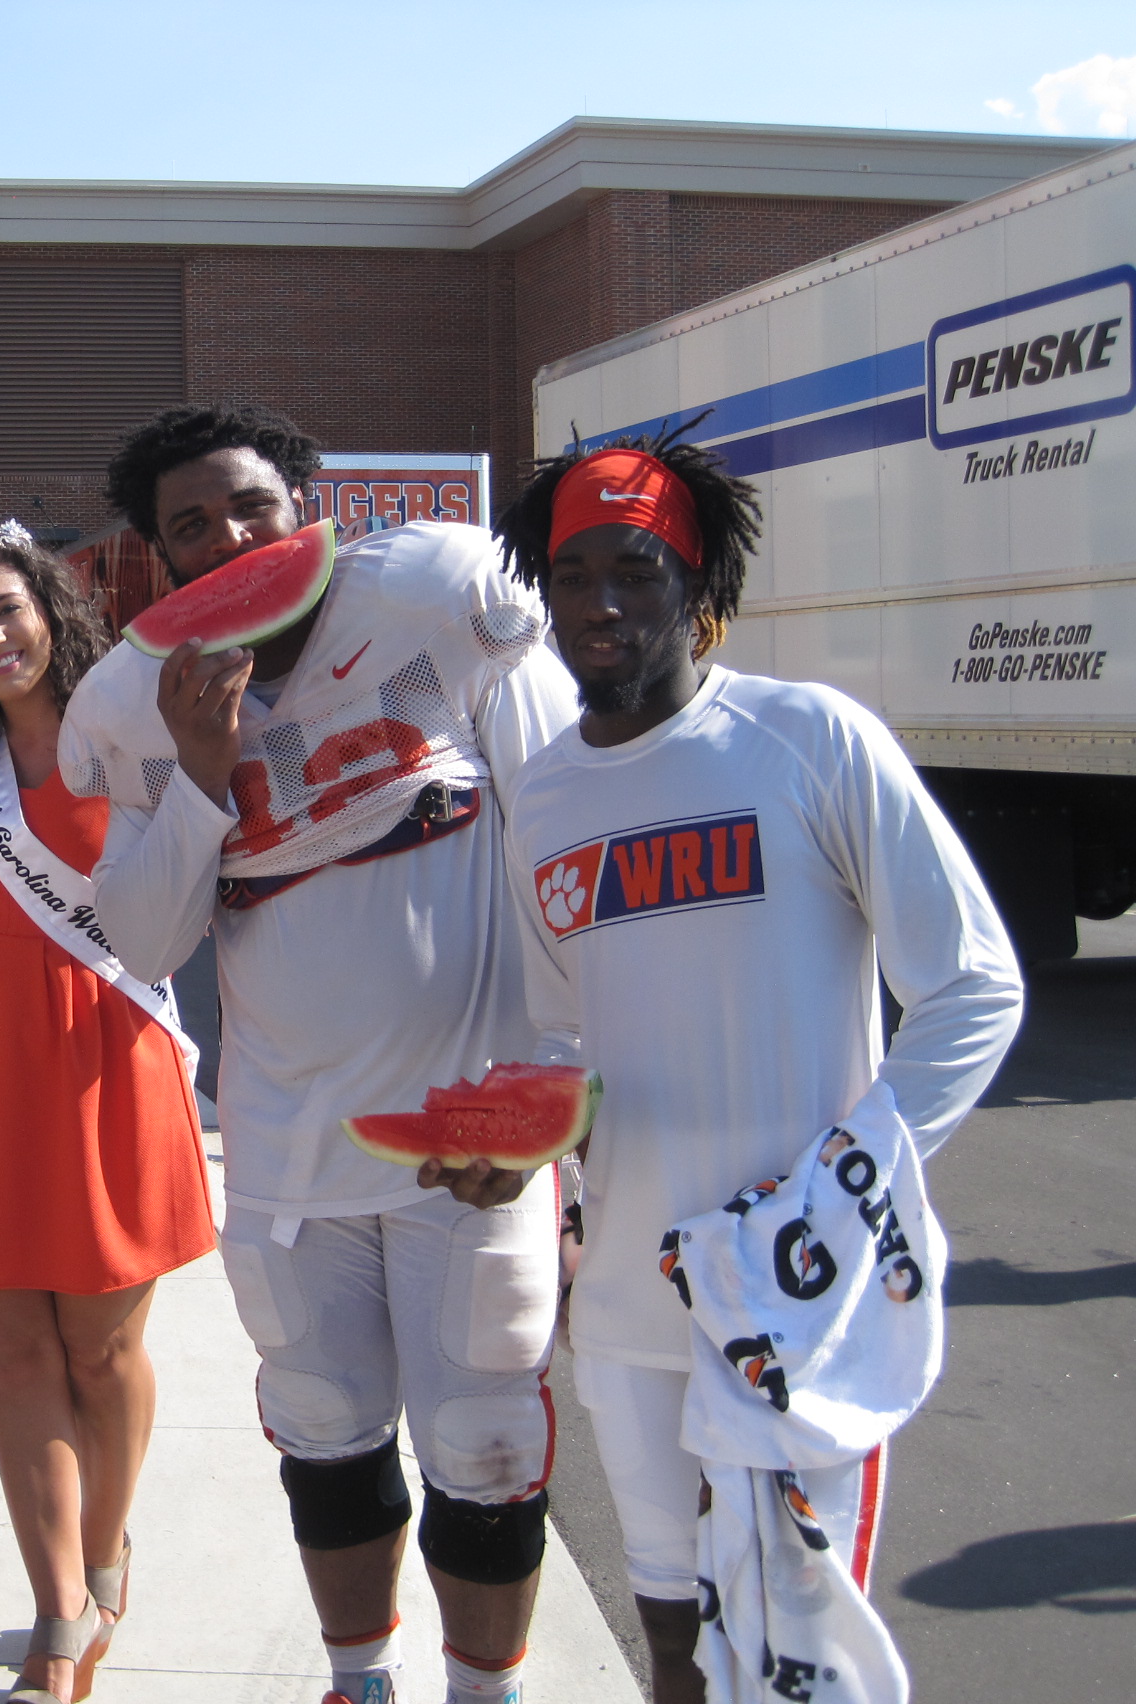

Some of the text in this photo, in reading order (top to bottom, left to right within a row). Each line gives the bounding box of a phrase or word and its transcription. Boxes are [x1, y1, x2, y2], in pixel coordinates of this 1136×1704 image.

[942, 316, 1123, 405] PENSKE
[963, 429, 1096, 485] Truck Rental
[307, 482, 469, 528] IGERS
[968, 620, 1093, 651] GoPenske.com
[951, 651, 1107, 683] 1-800-GO-PENSKE
[612, 822, 755, 909] WRU
[150, 980, 170, 1002] on
[773, 1217, 838, 1301] G
